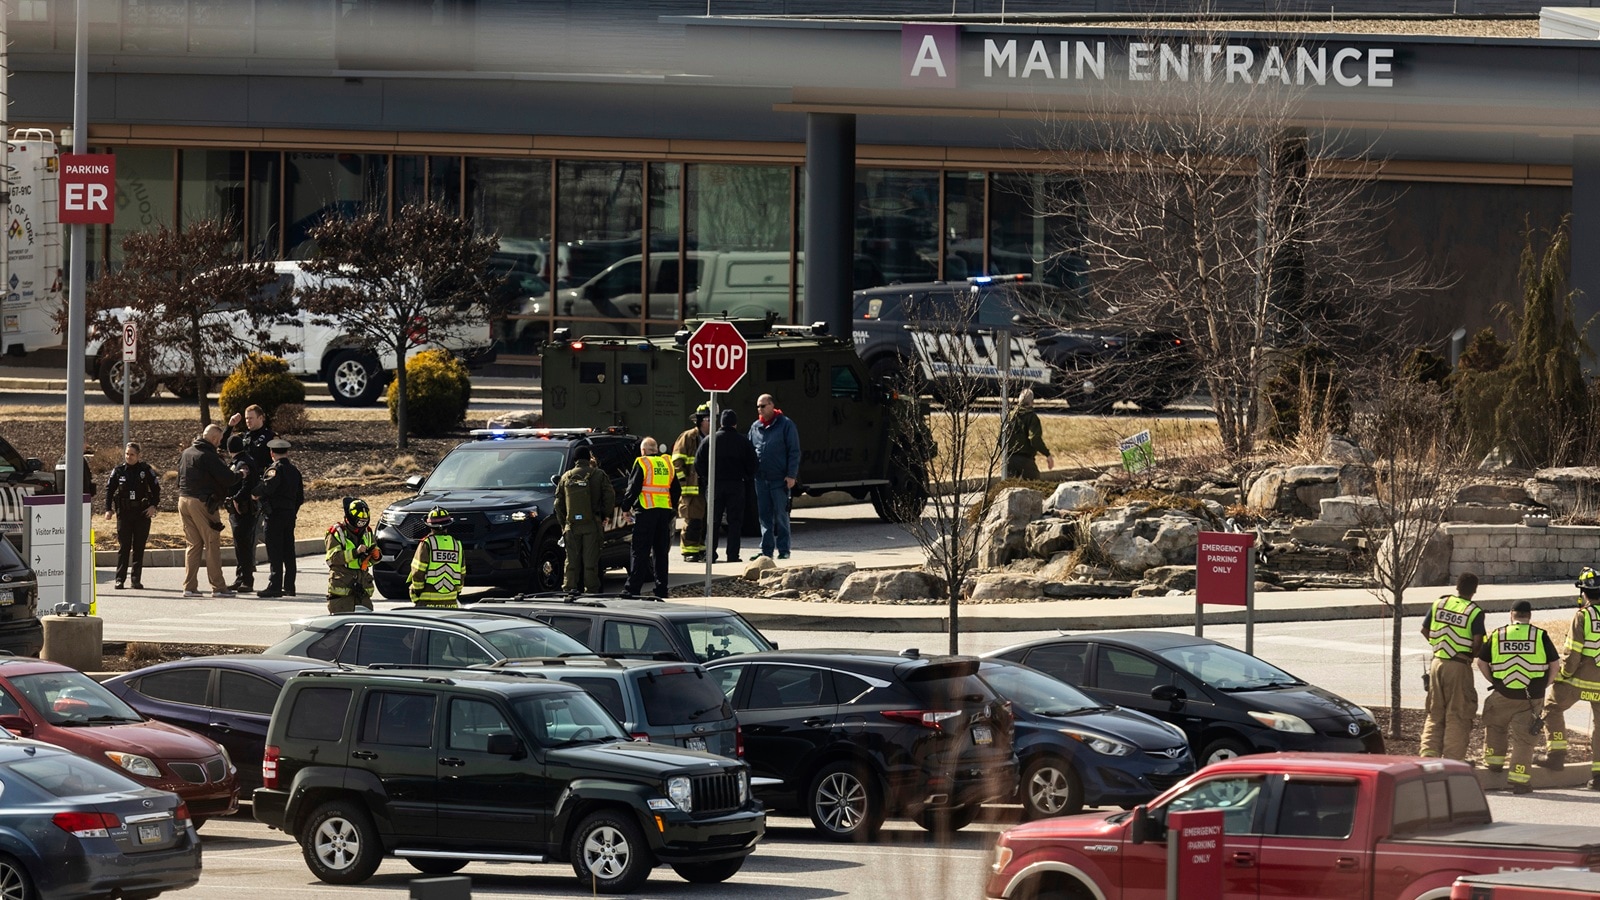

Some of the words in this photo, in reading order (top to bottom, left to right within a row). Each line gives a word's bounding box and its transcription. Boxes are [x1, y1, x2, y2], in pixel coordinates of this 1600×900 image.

[910, 34, 947, 78] A
[983, 38, 1106, 80] MAIN
[1128, 41, 1395, 88] ENTRANCE
[65, 165, 110, 175] PARKING
[65, 183, 108, 211] ER
[14, 204, 25, 216] OF
[23, 214, 35, 246] YORK
[852, 330, 870, 339] DIAL
[691, 343, 744, 370] STOP
[801, 447, 853, 465] POLICE
[35, 528, 51, 536] Visitor
[52, 527, 65, 535] Parki
[1201, 543, 1243, 553] EMERGENCY
[436, 551, 457, 561] E502
[1207, 555, 1238, 563] PARKING
[35, 569, 47, 577] Main
[48, 568, 64, 577] Entran
[1212, 565, 1232, 574] ONLY
[1503, 642, 1530, 651] R505
[1515, 764, 1526, 774] 50
[1182, 825, 1221, 837] EMERGENCY
[1187, 840, 1216, 850] PARKING
[1192, 854, 1211, 864] ONLY
